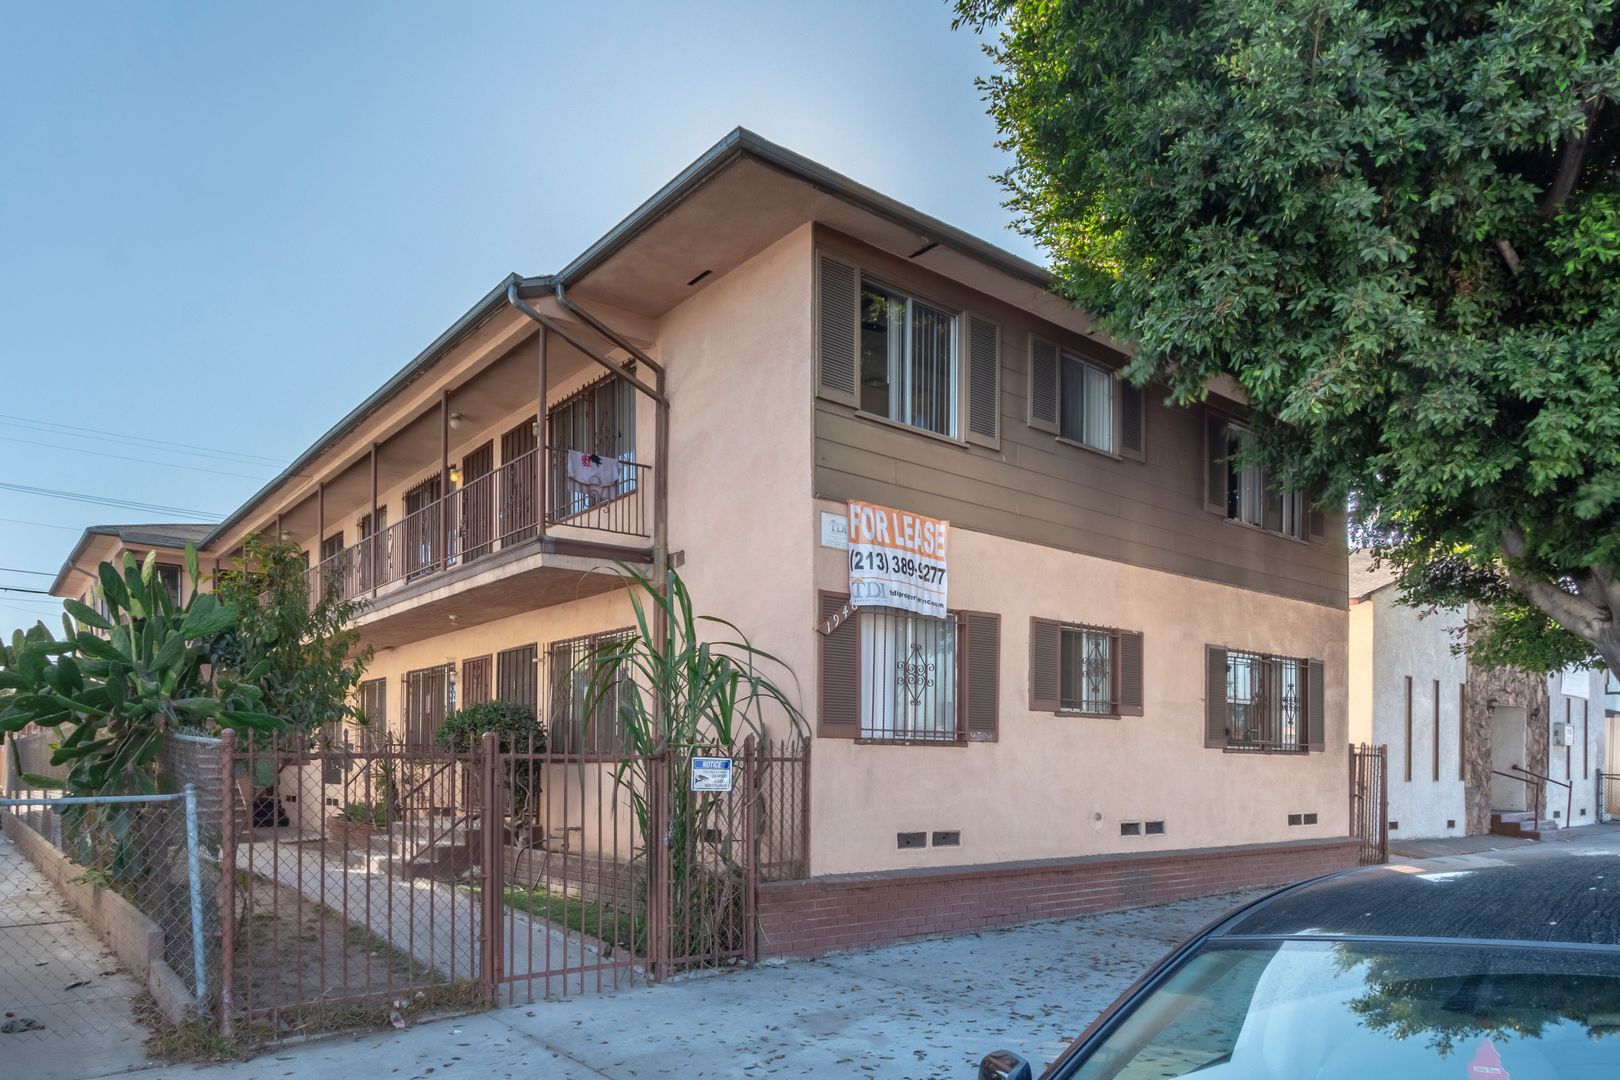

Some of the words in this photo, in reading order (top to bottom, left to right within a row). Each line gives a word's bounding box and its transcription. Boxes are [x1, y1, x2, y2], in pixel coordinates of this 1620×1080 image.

[850, 504, 890, 544] FOR
[892, 512, 945, 556] LEASE
[850, 549, 889, 574] (213)
[851, 581, 888, 599] TDI
[702, 760, 721, 769] NOTICE
